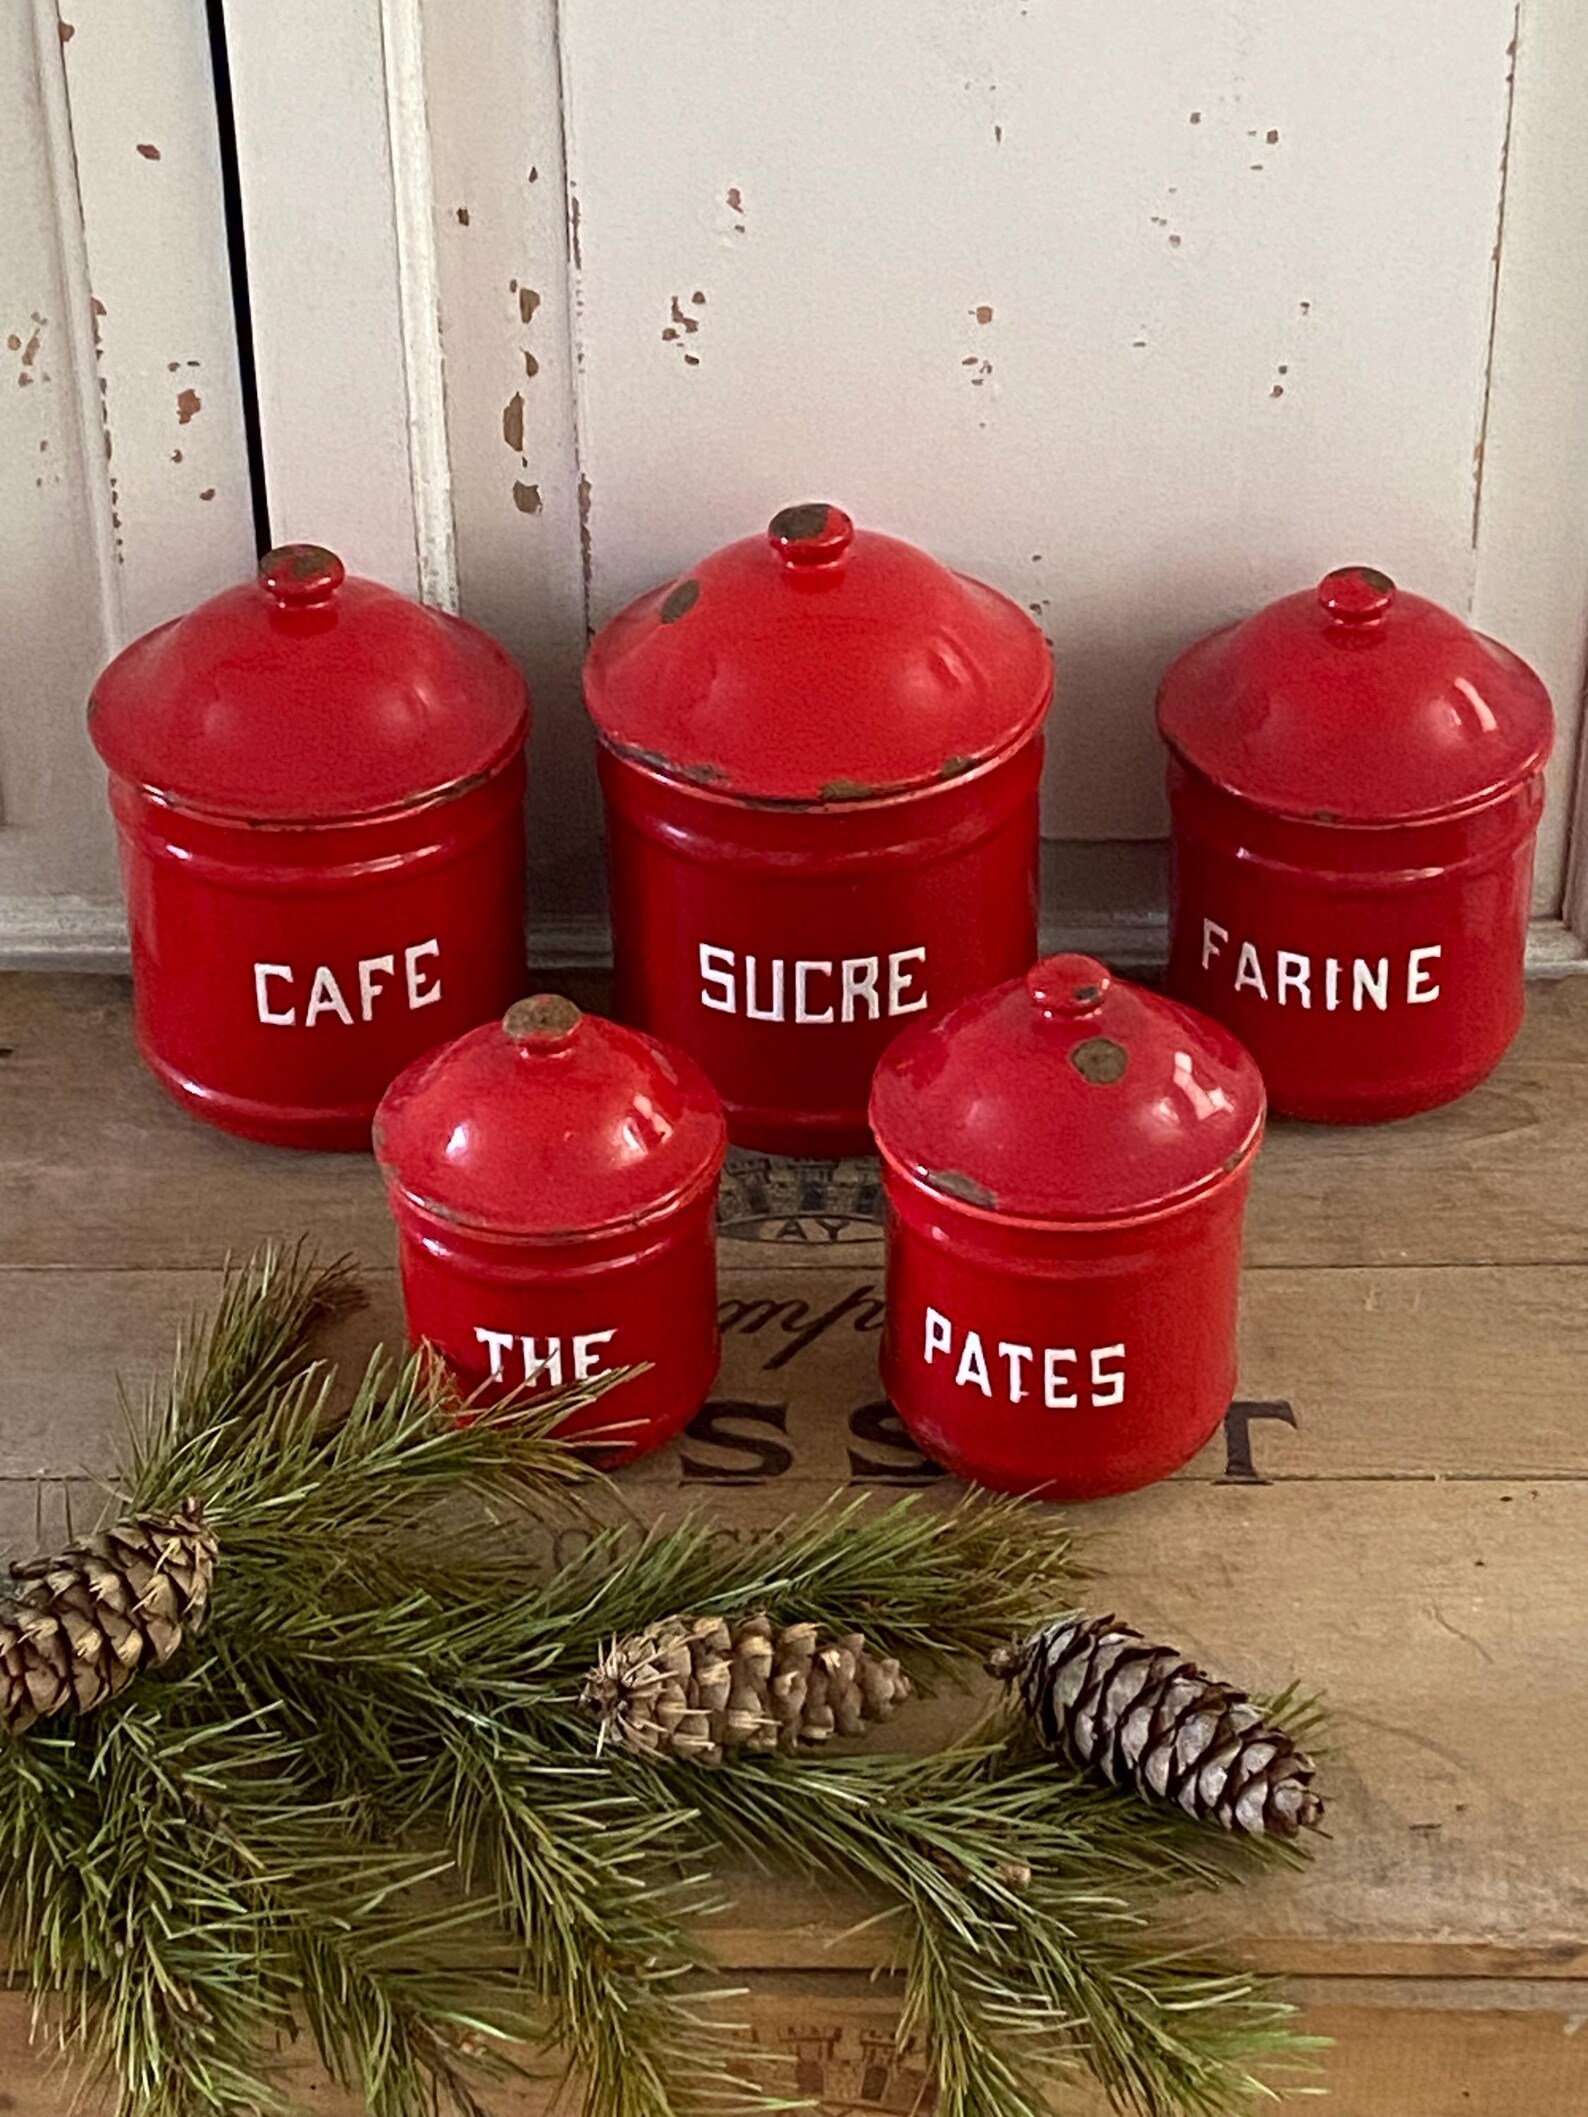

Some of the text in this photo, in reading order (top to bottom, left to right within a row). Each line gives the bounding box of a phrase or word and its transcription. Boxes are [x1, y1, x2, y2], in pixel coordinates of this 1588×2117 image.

[252, 937, 442, 1028] CAFE
[699, 943, 928, 1024] SUCRE
[1202, 917, 1442, 1012] FARINE
[473, 1325, 619, 1387] THE
[922, 1306, 1126, 1409] PATES
